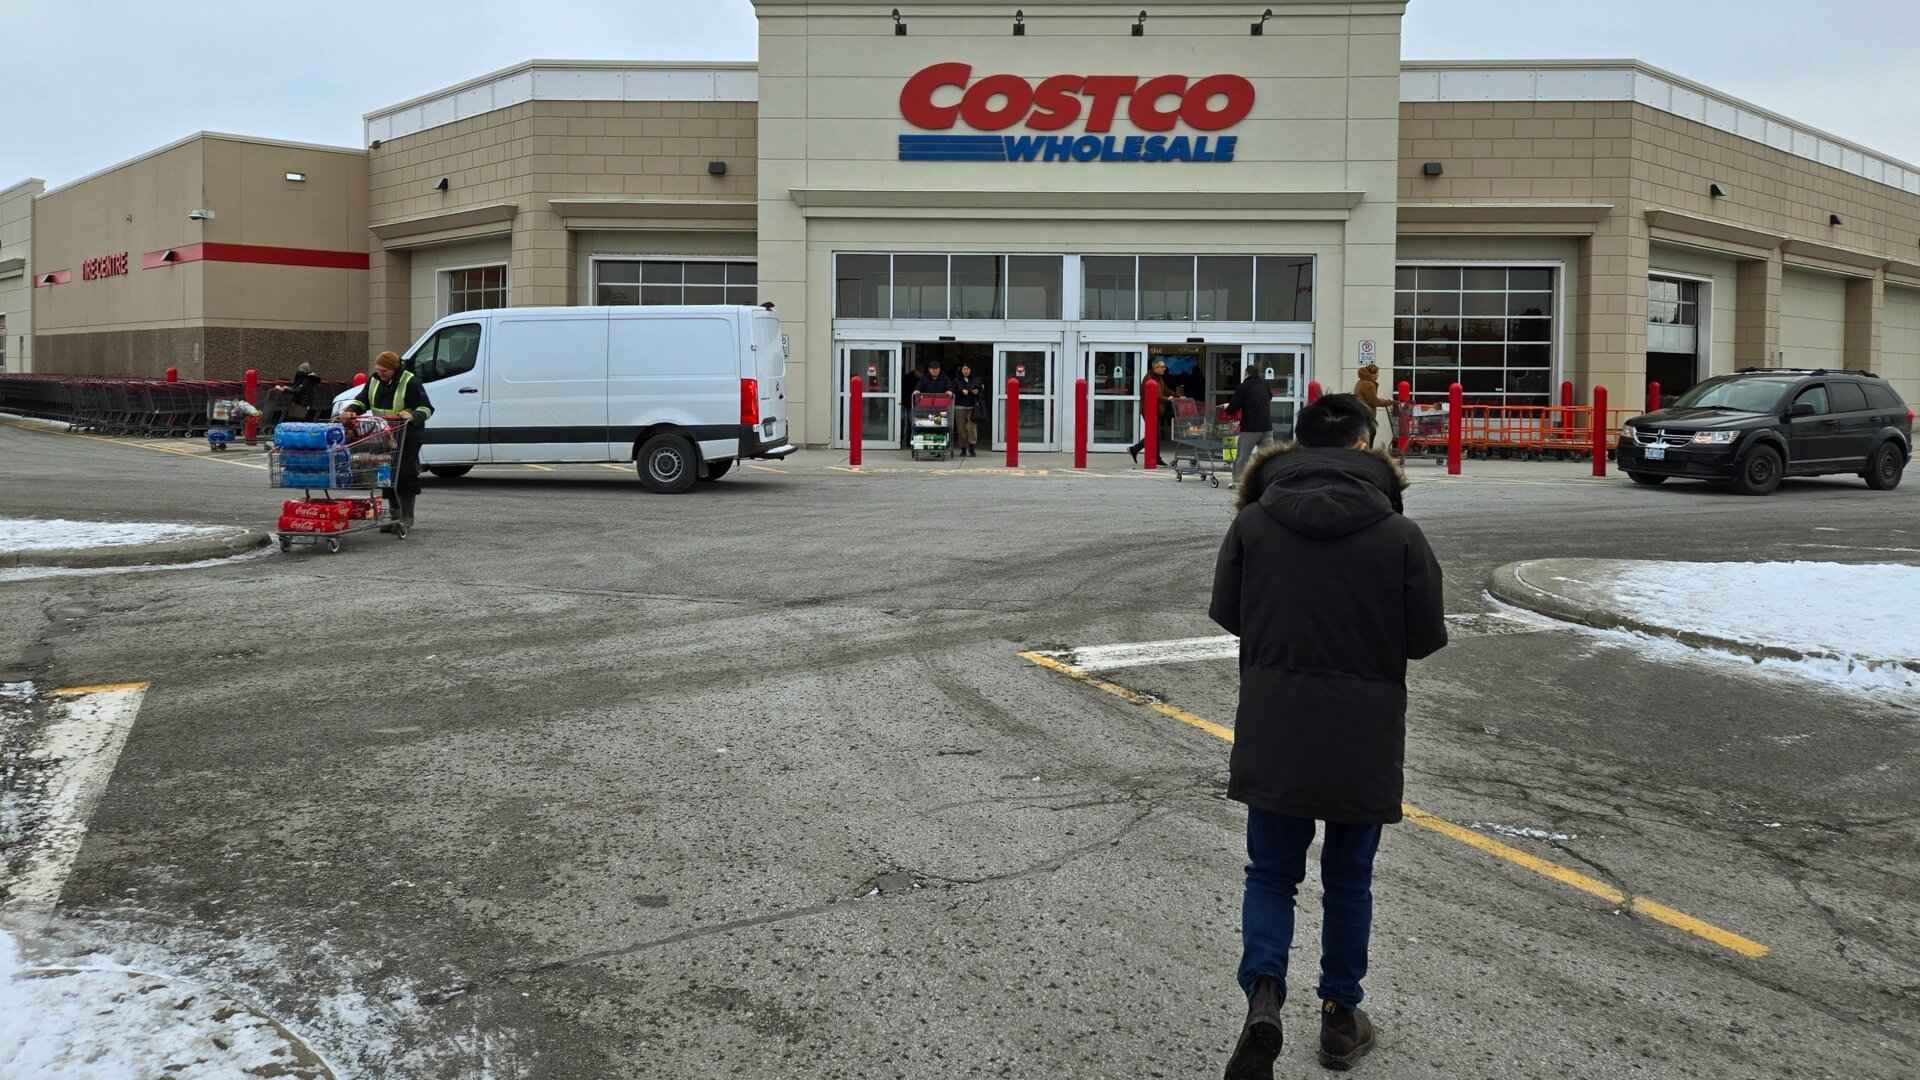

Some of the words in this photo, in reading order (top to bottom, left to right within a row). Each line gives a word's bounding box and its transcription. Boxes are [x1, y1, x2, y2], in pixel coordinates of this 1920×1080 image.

[899, 62, 1255, 132] COSTCO
[1005, 135, 1237, 162] WHOLESALE
[97, 251, 129, 278] CENTRE
